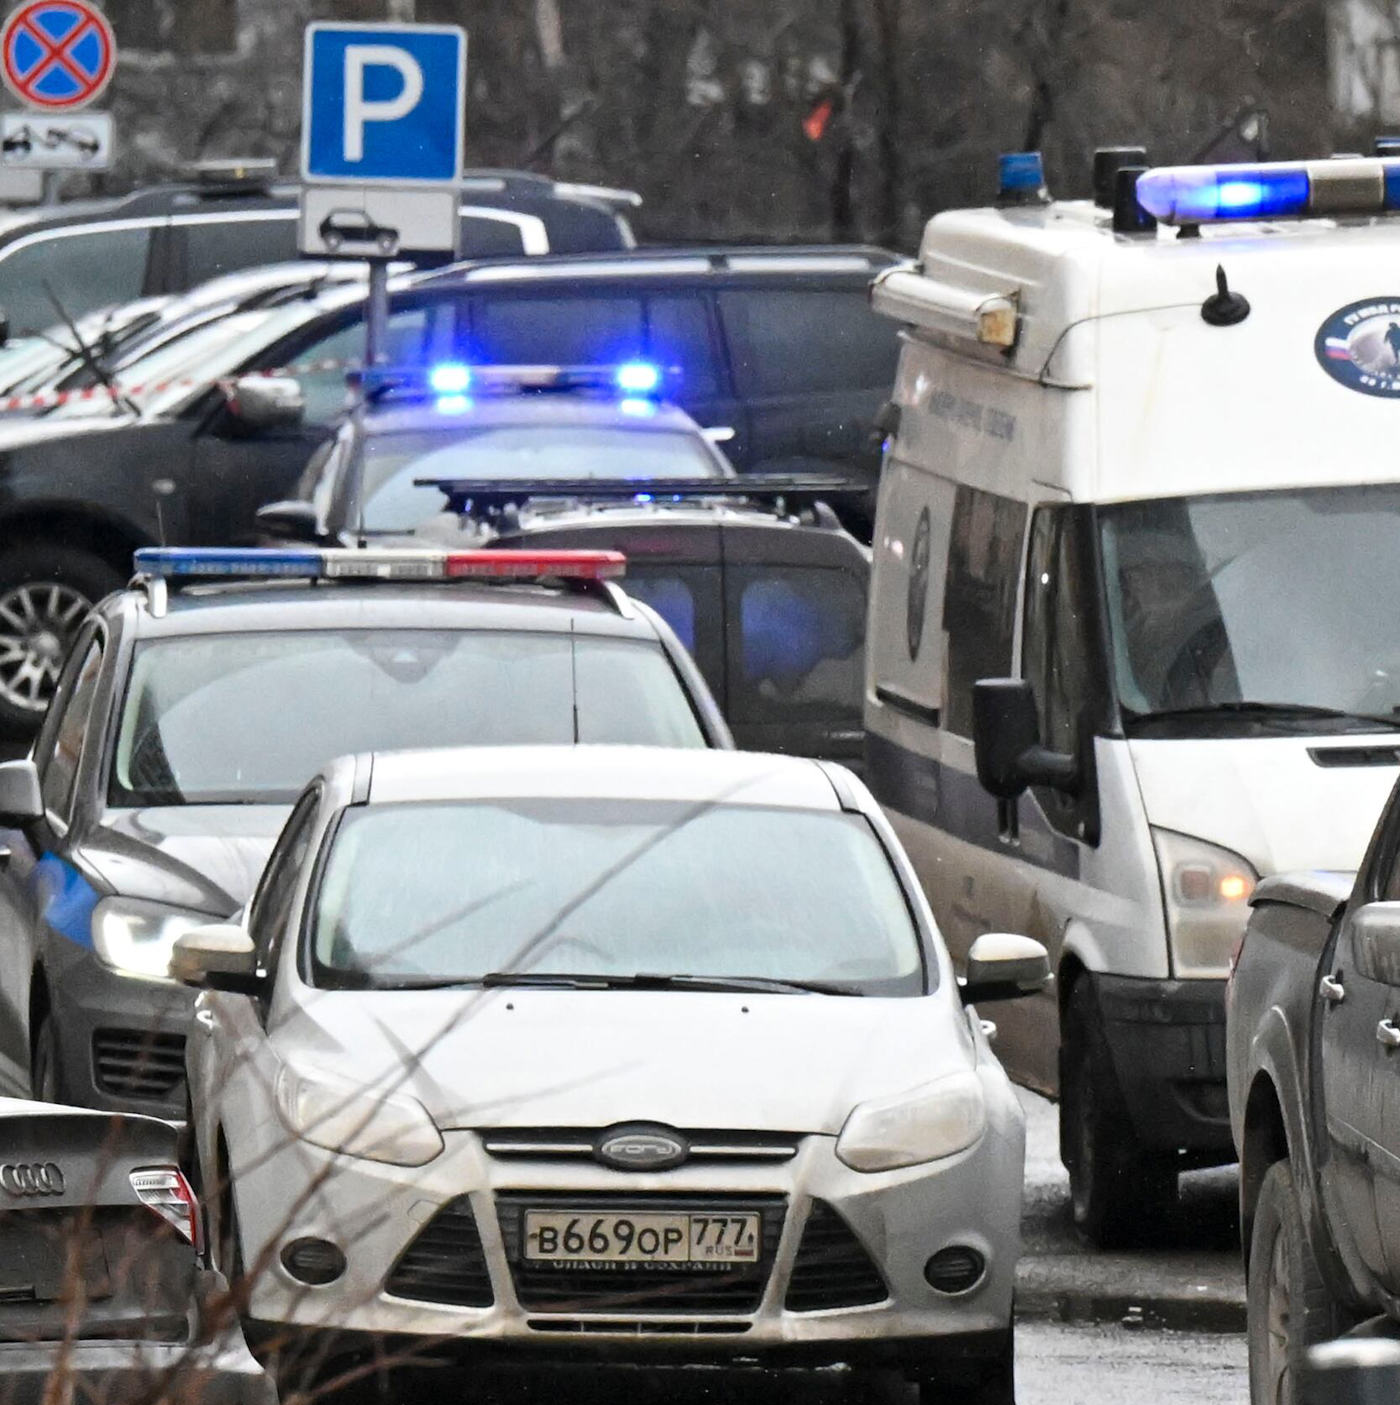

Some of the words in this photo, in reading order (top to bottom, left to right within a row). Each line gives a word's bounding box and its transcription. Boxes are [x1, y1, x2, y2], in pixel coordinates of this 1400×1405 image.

[342, 44, 425, 163] P
[609, 1143, 673, 1155] Ford
[537, 1217, 684, 1256] В669ОР
[692, 1217, 748, 1246] 777
[705, 1246, 733, 1257] RUS
